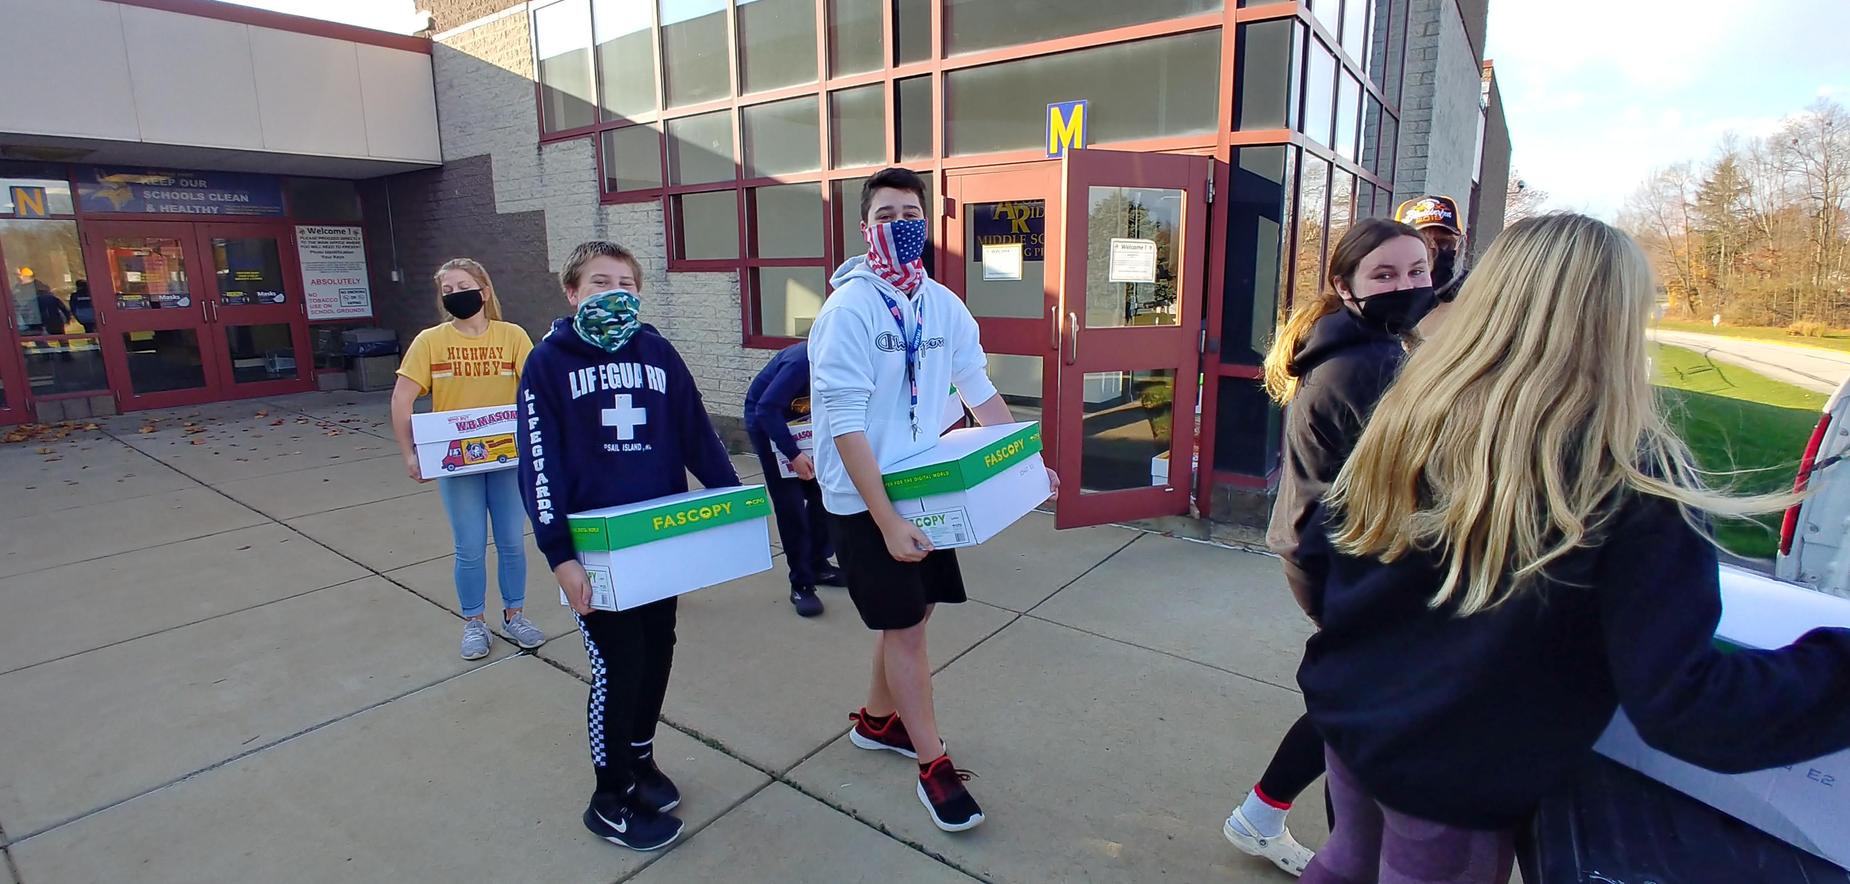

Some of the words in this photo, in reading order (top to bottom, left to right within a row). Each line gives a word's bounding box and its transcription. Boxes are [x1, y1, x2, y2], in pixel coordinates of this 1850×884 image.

[1050, 104, 1083, 154] M
[180, 178, 208, 188] OUR
[15, 187, 45, 216] N
[143, 190, 204, 201] SCHOOLS
[209, 193, 249, 202] CLEAN
[159, 204, 220, 214] HEALTHY
[307, 227, 346, 235] Welcome
[447, 346, 503, 361] HIGHWAY
[453, 361, 500, 377] HONEY
[568, 362, 667, 400] LIFEGUARD
[524, 389, 552, 511] LIFEGUARD
[983, 437, 1025, 468] FASCOPY
[914, 474, 932, 482] DIGITAL
[933, 470, 950, 479] WORLD
[652, 501, 733, 531] FASCOPY
[1807, 767, 1836, 787] E2
